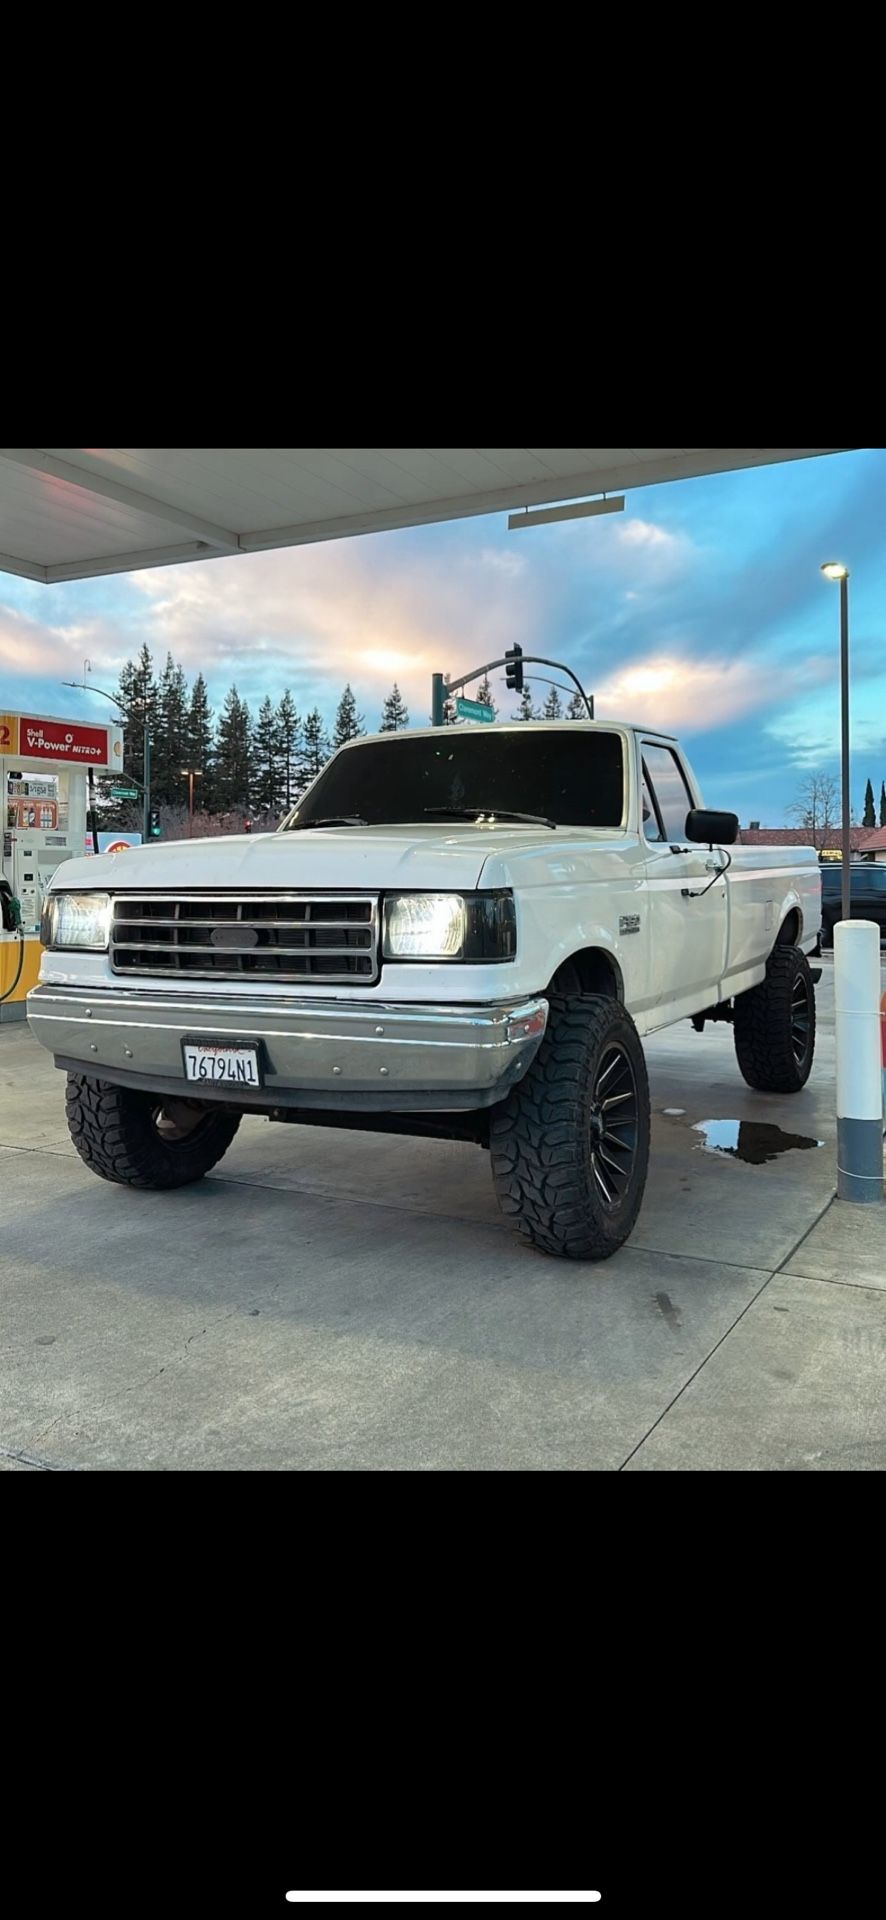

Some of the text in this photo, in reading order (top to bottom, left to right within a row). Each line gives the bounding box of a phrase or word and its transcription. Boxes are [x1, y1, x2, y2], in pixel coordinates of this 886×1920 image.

[0, 725, 10, 745] 2
[27, 728, 44, 738] Shell
[27, 737, 71, 752] V-Power
[188, 1055, 256, 1082] 76794N1
